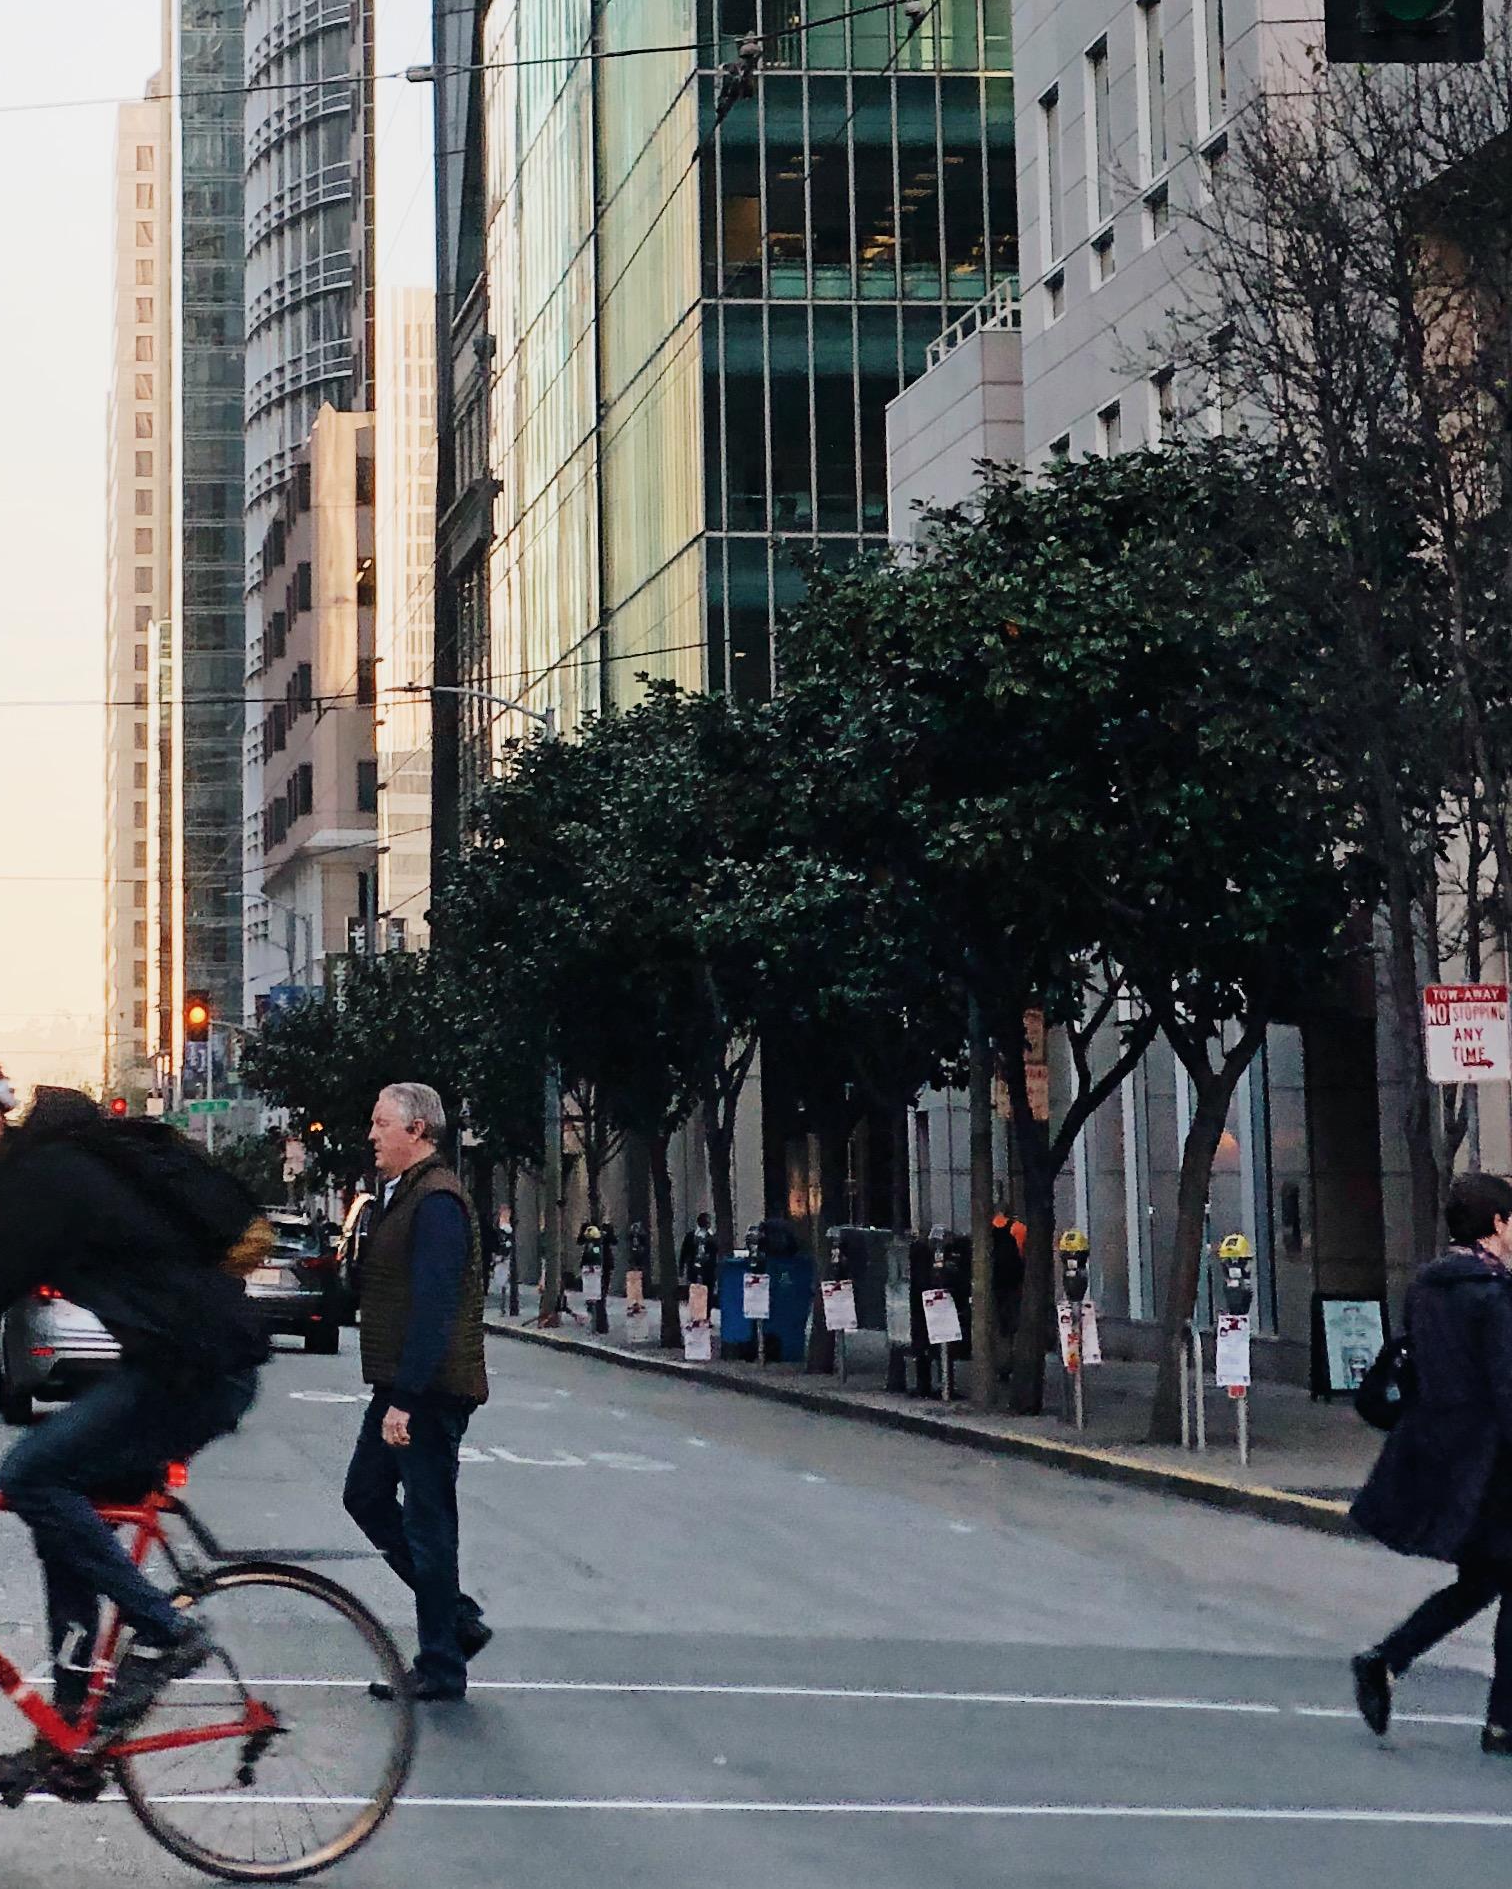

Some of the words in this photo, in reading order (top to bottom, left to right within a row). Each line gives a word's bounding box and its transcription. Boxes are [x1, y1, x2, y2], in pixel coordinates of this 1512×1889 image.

[1432, 989, 1500, 1001] TOW-AWAY
[1427, 1002, 1448, 1025] NO
[1452, 1004, 1505, 1022] STOPPING
[1454, 1027, 1484, 1042] ANY
[1451, 1046, 1486, 1063] TIME
